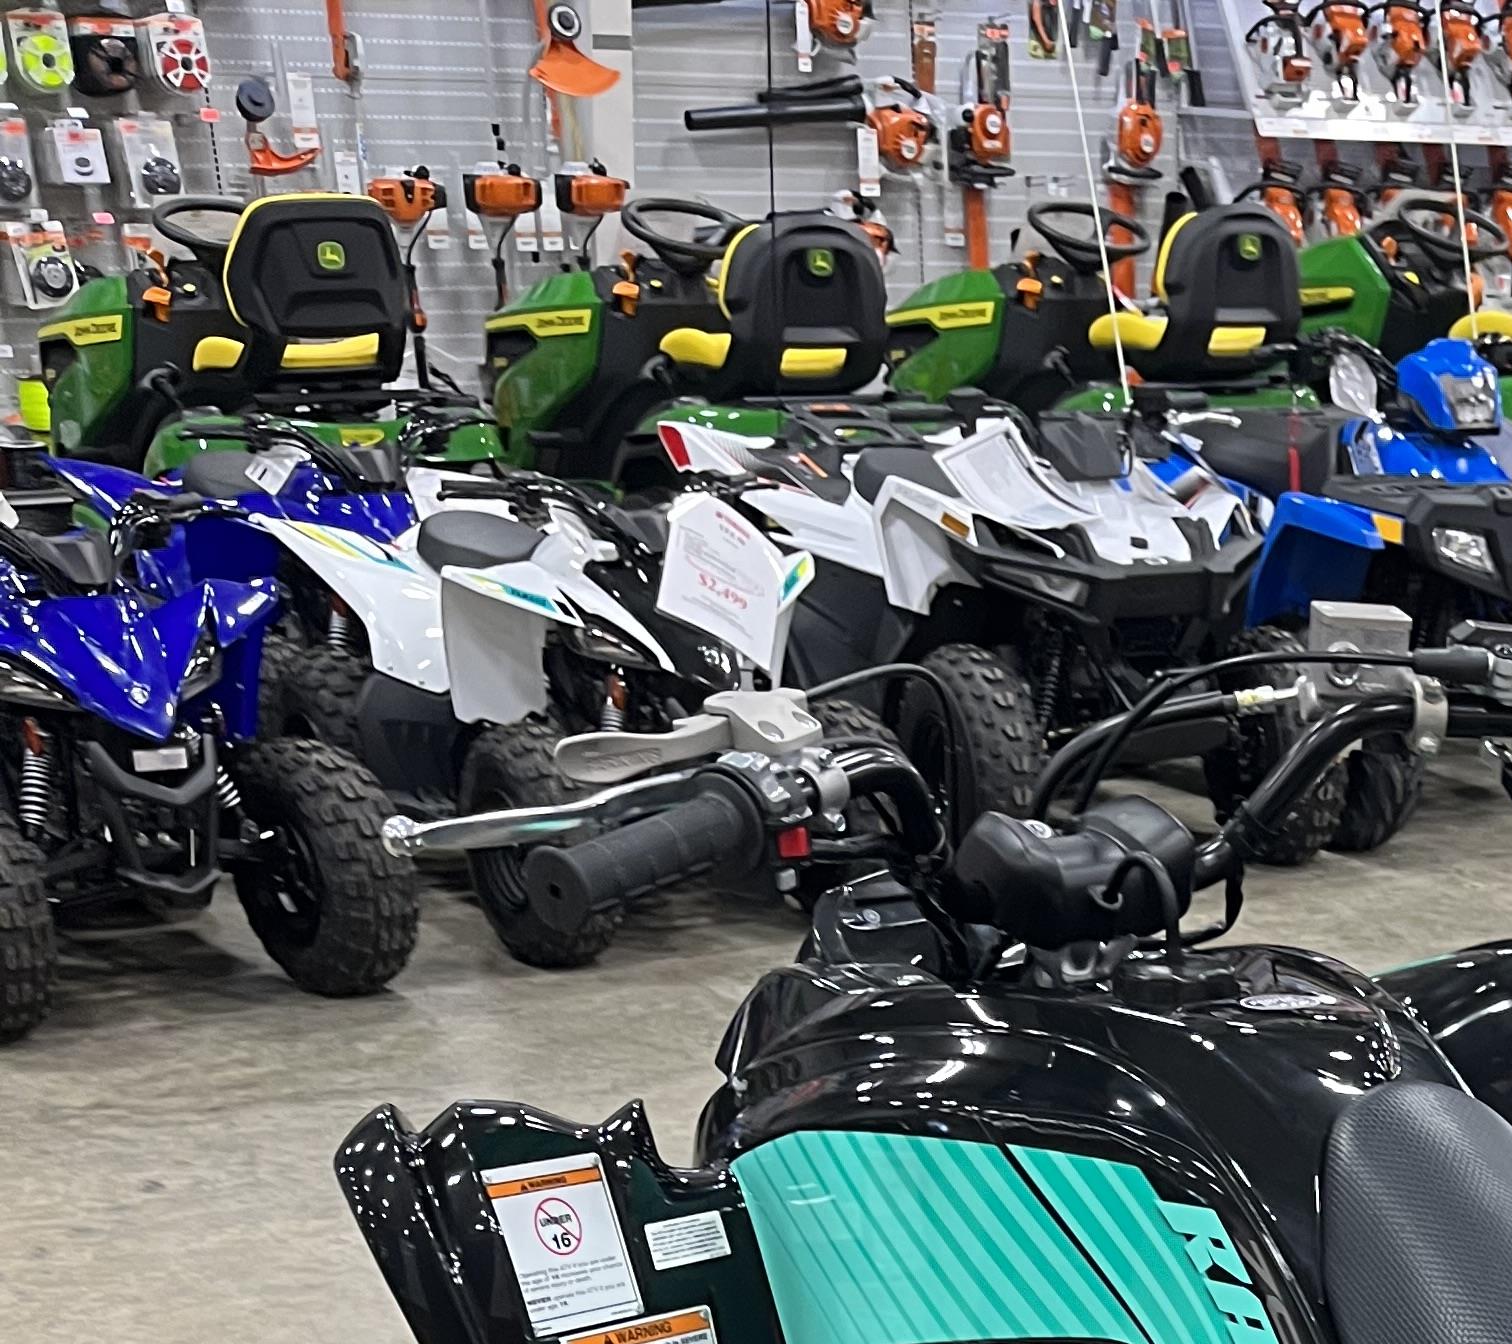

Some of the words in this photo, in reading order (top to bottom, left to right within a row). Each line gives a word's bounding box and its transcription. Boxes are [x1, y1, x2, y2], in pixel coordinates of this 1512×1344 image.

[539, 1214, 572, 1228] UNDER
[552, 1233, 572, 1249] 16
[616, 1321, 673, 1344] WARNING
[681, 1333, 708, 1344] SEVERE
